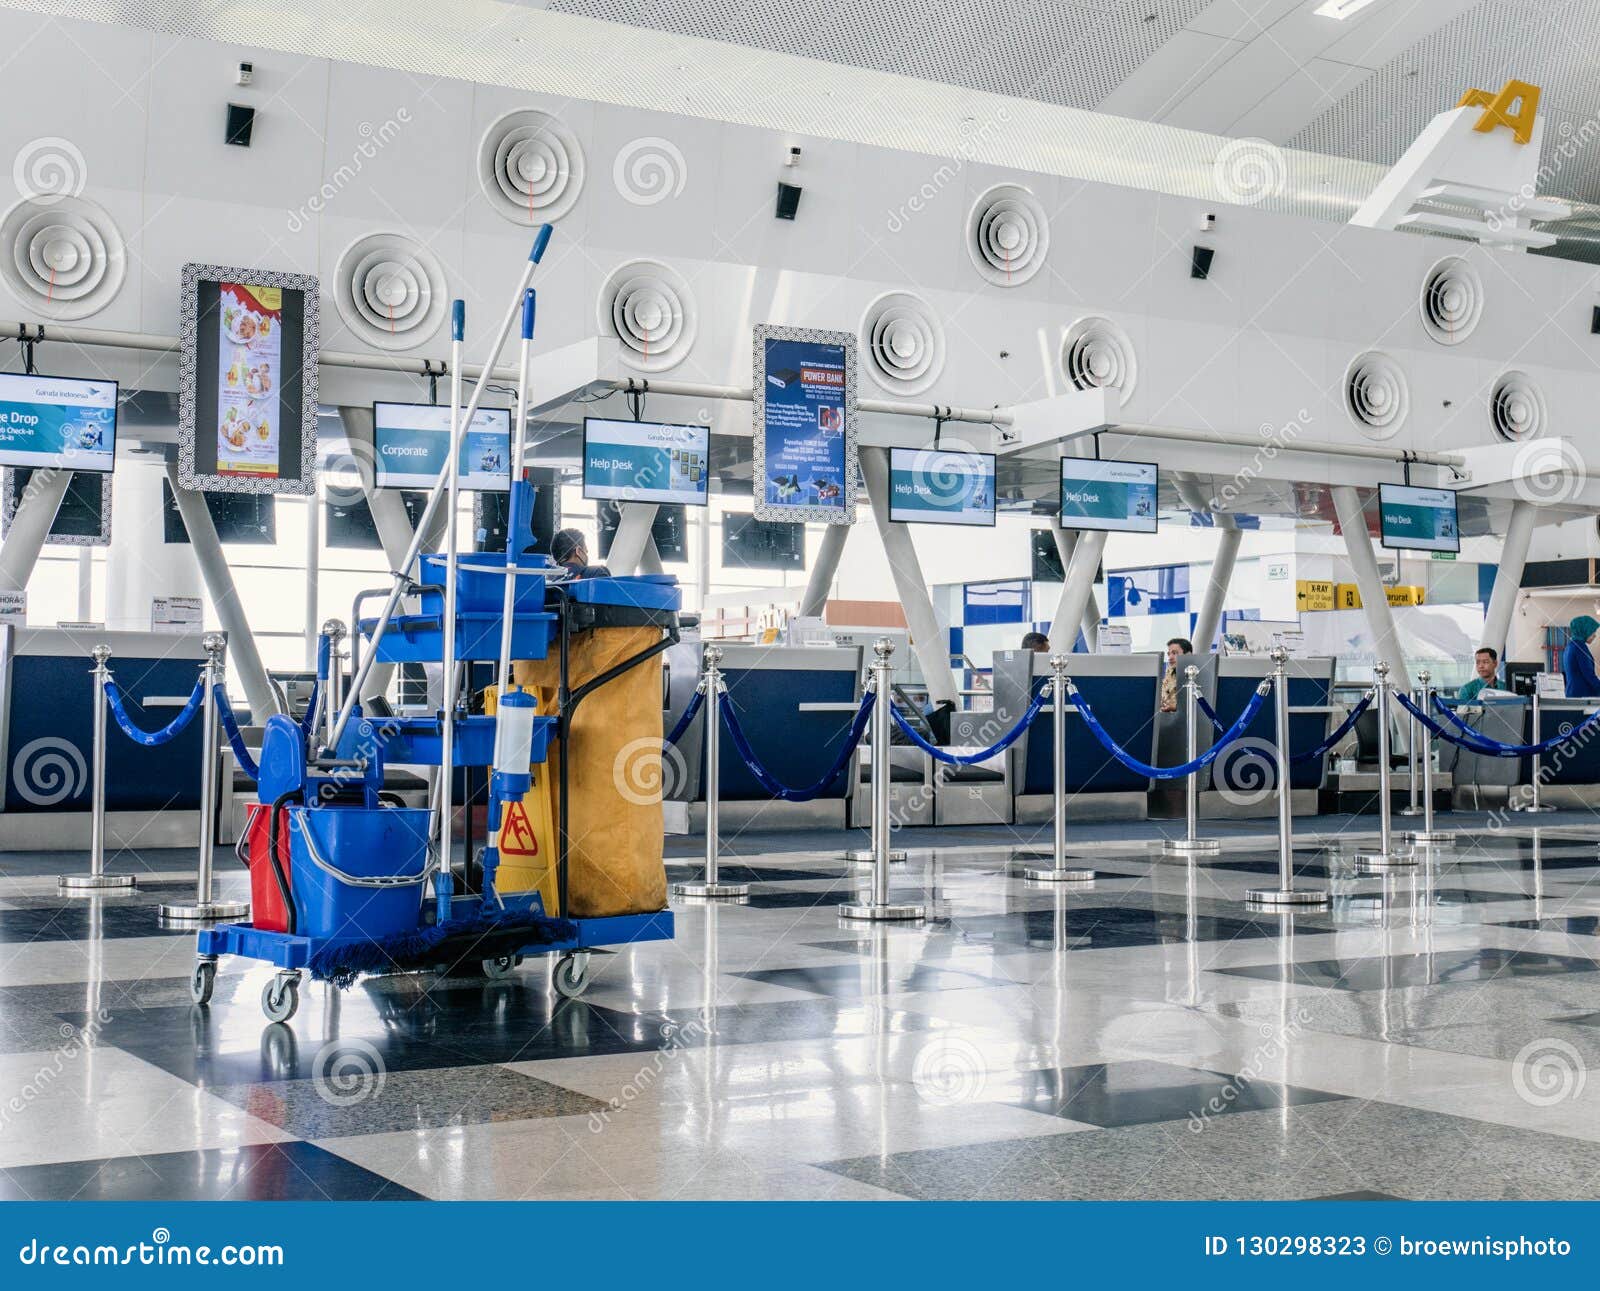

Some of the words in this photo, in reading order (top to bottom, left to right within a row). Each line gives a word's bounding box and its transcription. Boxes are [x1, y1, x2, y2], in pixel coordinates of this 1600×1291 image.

[803, 371, 826, 382] POWER
[826, 372, 843, 384] BANK
[11, 411, 39, 426] Drop
[7, 427, 34, 436] Check-in
[381, 444, 429, 457] Corporate
[590, 457, 610, 470] Help
[612, 459, 633, 471] Desk
[895, 484, 912, 494] Help
[914, 485, 932, 496] Desk
[1066, 492, 1082, 502] Help
[1082, 493, 1100, 503] Desk
[1311, 584, 1329, 593] X-RAY
[1386, 593, 1408, 602] arurat
